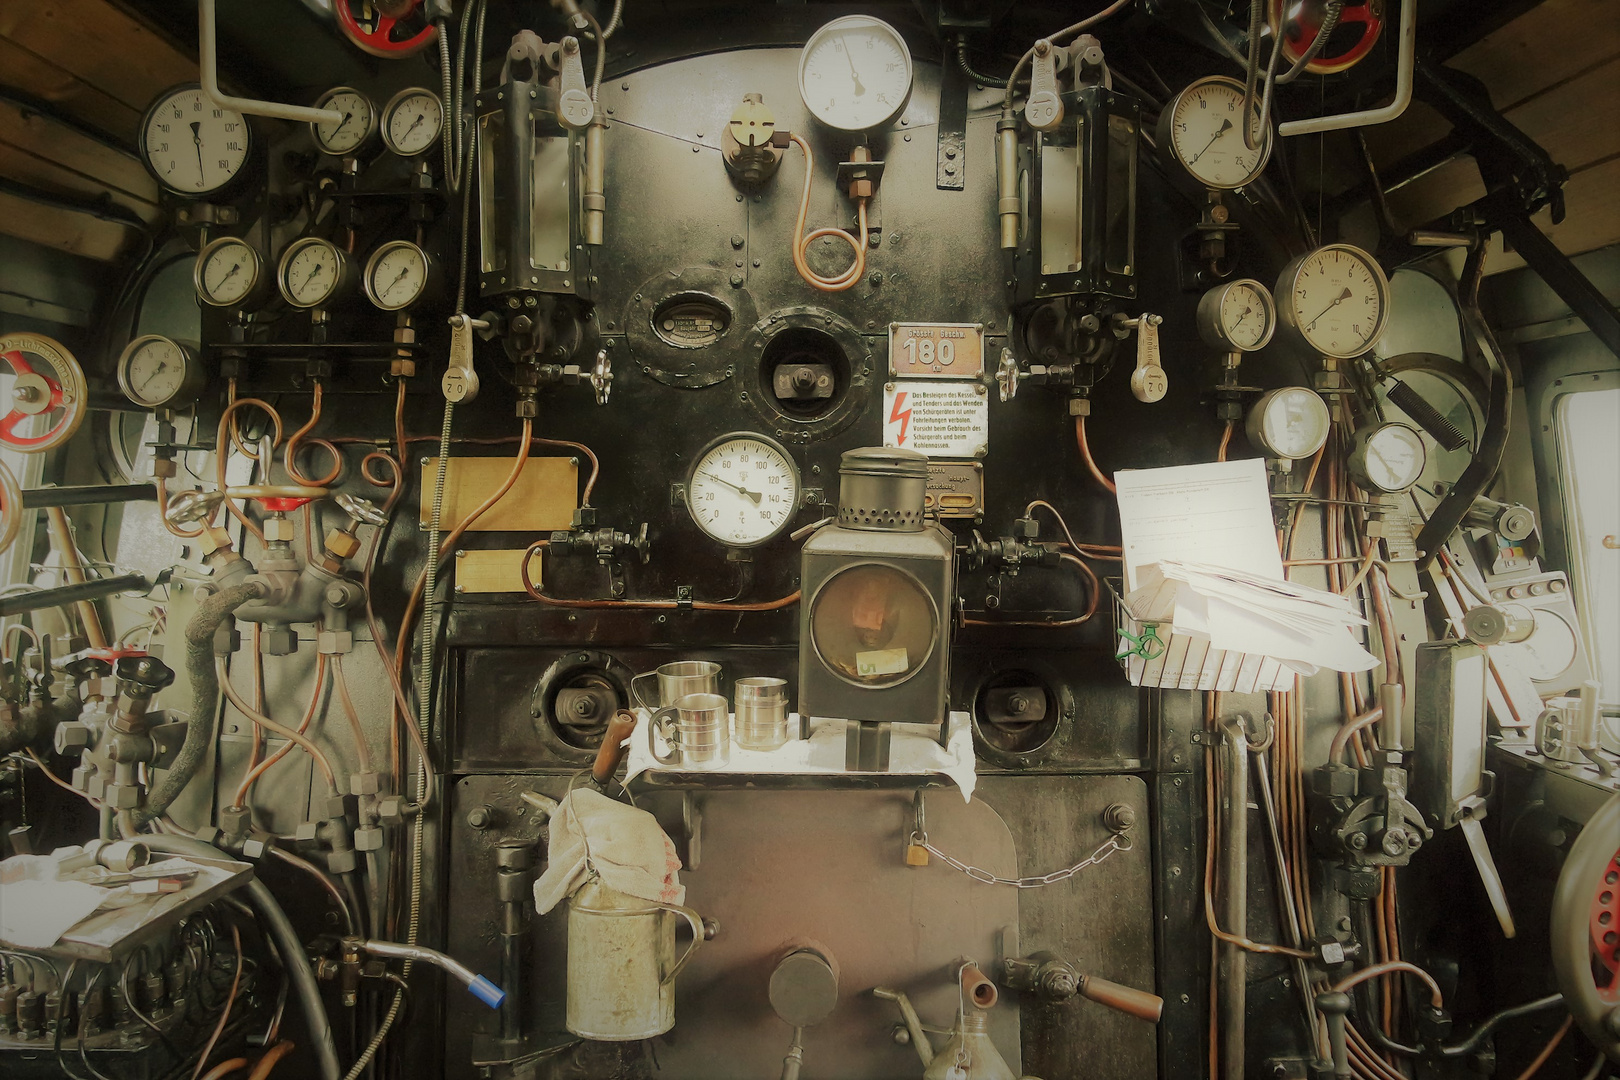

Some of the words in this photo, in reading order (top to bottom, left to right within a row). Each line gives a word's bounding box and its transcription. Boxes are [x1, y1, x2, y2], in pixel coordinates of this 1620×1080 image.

[835, 44, 842, 52] 10
[866, 41, 874, 50] 15
[886, 63, 894, 72] 20
[830, 98, 835, 106] 0
[877, 93, 885, 102] 25
[194, 103, 202, 111] 80
[1200, 100, 1206, 109] 10
[1228, 103, 1234, 111] 15
[175, 110, 182, 119] 60
[213, 110, 222, 118] 100
[568, 106, 574, 116] Z
[1033, 109, 1038, 118] Z
[162, 124, 170, 133] 40
[225, 123, 234, 132] 120
[1182, 123, 1186, 132] 5
[161, 143, 168, 152] 20
[227, 142, 237, 151] 140
[171, 161, 175, 170] 0
[219, 160, 228, 169] 160
[1236, 157, 1243, 165] 25
[1320, 266, 1324, 275] 4
[1349, 269, 1352, 278] 6
[1303, 290, 1306, 298] 2
[1365, 296, 1368, 304] 8
[1312, 321, 1316, 330] 0
[1353, 324, 1359, 333] 10
[940, 330, 965, 338] Geschw.
[904, 338, 954, 365] 180
[447, 383, 452, 393] Z
[1148, 382, 1153, 392] Z
[860, 663, 876, 673] 5
